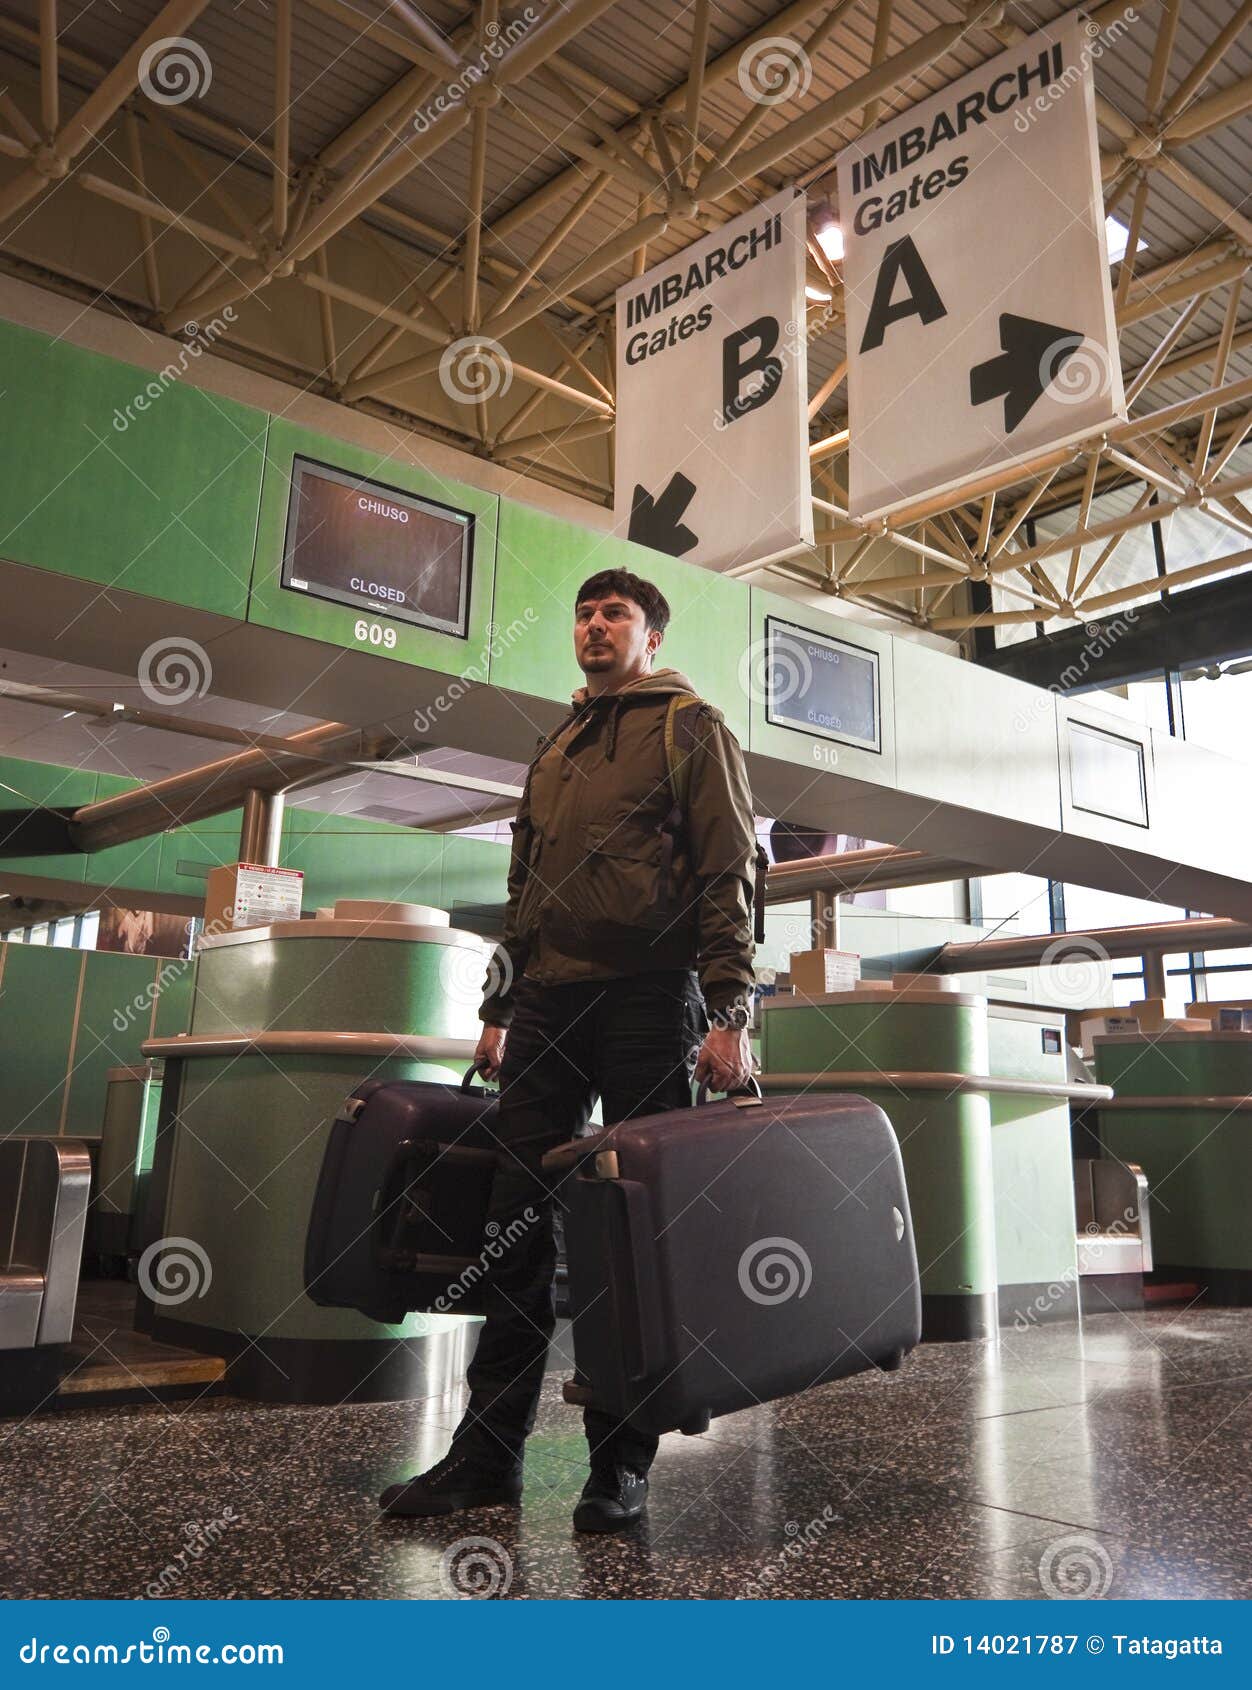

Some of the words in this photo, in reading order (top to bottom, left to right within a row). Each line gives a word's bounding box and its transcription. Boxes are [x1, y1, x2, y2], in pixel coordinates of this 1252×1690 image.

[852, 41, 1063, 195] IMBARCHI
[853, 155, 969, 236] Gates
[626, 212, 782, 329] IMBARCHI
[859, 233, 948, 354] A
[625, 303, 713, 366] Gates
[722, 315, 783, 426] B
[358, 497, 409, 523] CHIUSO
[350, 577, 406, 604] CLOSED
[354, 619, 397, 649] 609
[808, 646, 840, 664] CHIUSO
[808, 711, 842, 729] CLOSED
[813, 744, 839, 766] 610
